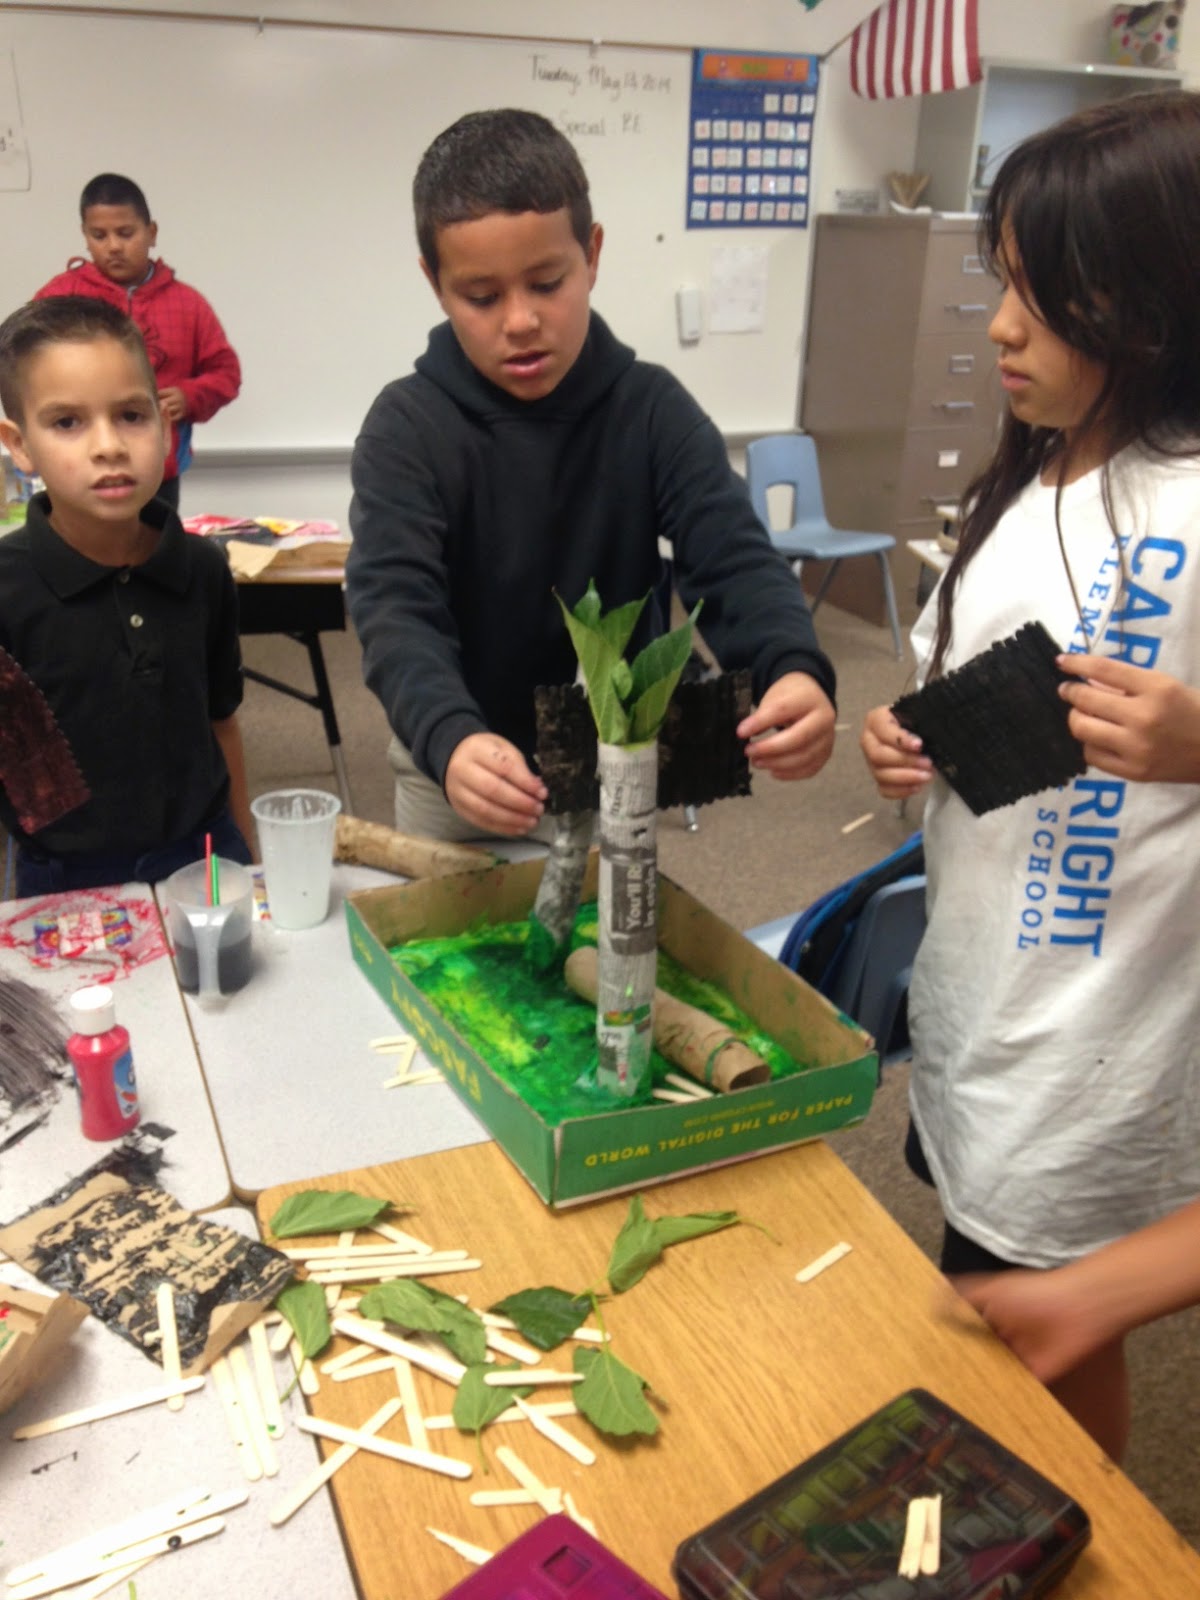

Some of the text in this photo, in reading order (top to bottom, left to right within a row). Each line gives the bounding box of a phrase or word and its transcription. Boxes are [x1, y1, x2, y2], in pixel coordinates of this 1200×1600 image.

[1018, 808, 1058, 949] SCHOOL
[804, 1094, 853, 1116] PAPER
[731, 1118, 761, 1134] THE
[767, 1108, 799, 1125] FOR
[659, 1127, 725, 1151] DIGITAL
[584, 1145, 649, 1167] WORLD
